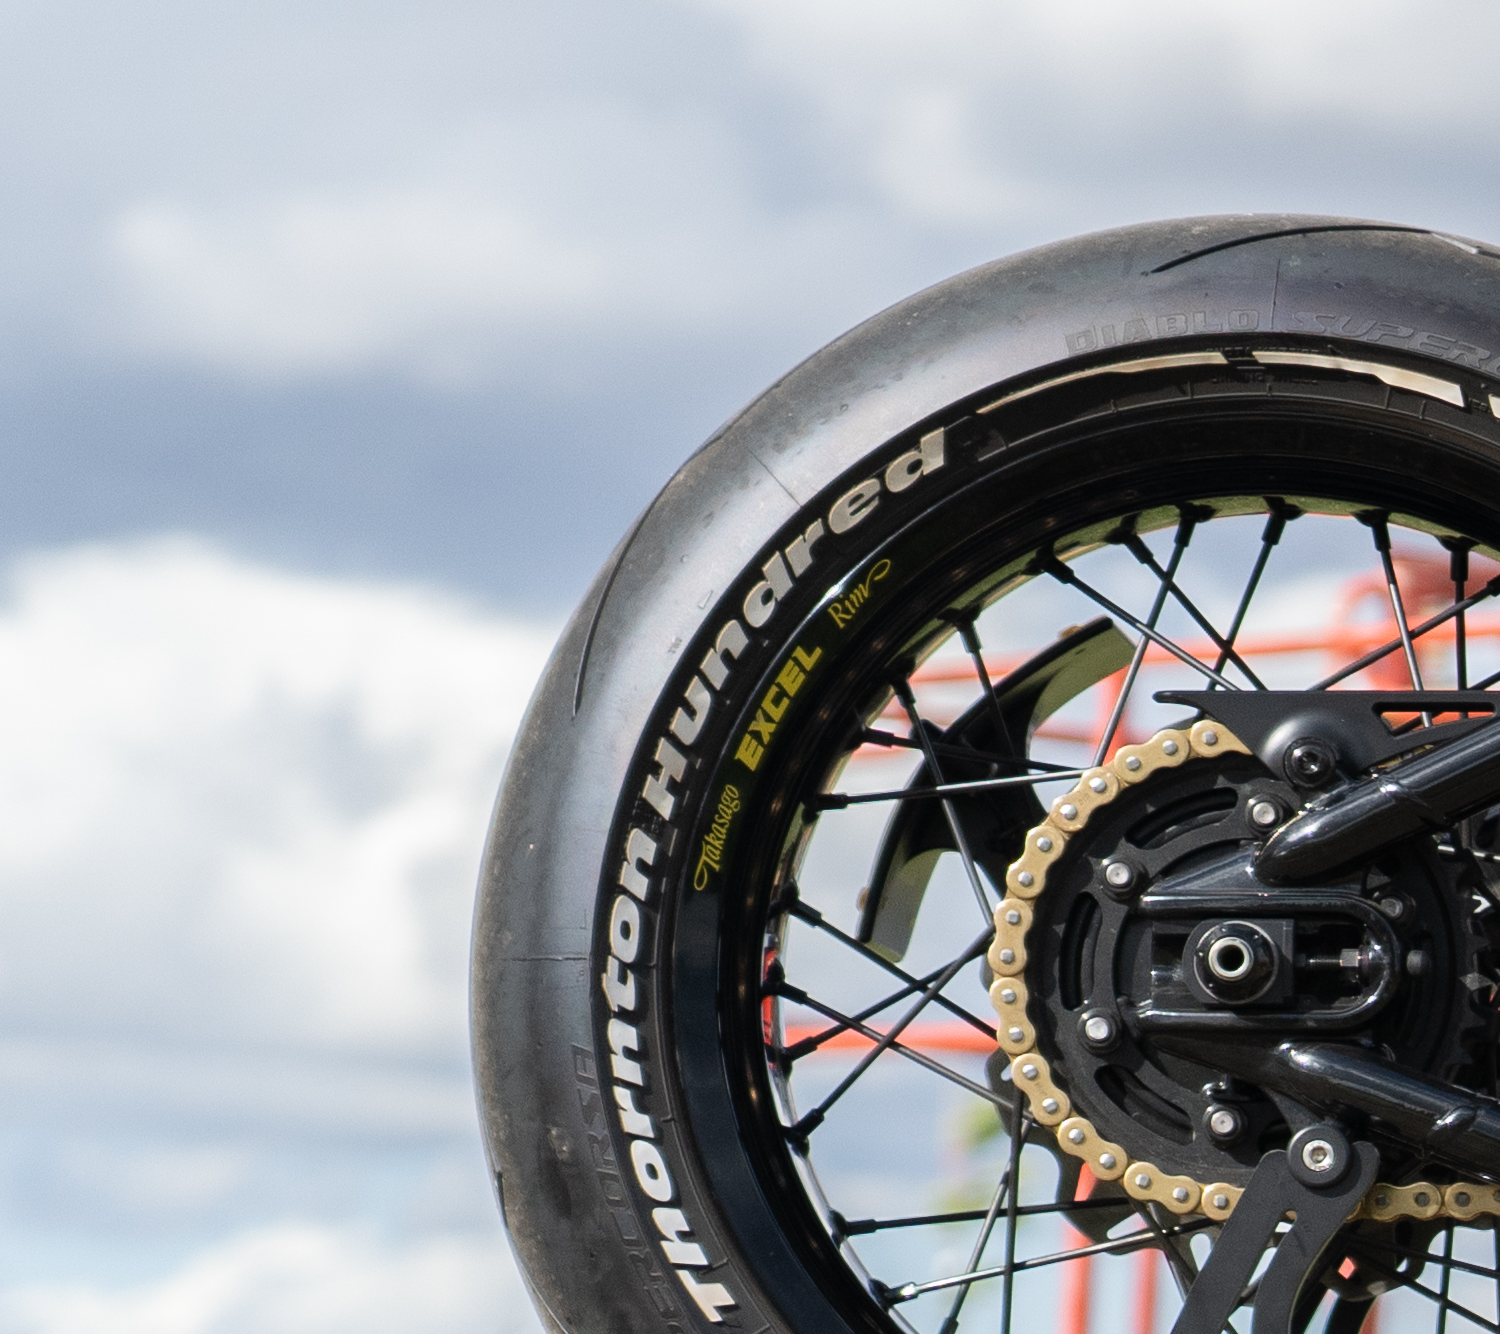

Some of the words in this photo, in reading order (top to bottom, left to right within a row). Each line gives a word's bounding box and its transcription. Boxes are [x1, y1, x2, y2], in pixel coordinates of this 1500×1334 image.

[1063, 308, 1260, 357] DIABLO
[641, 427, 946, 820] Hundred
[694, 783, 740, 893] Takasago
[735, 645, 821, 773] EXCEL
[827, 558, 892, 631] Rim
[602, 827, 738, 1324] Thornton
